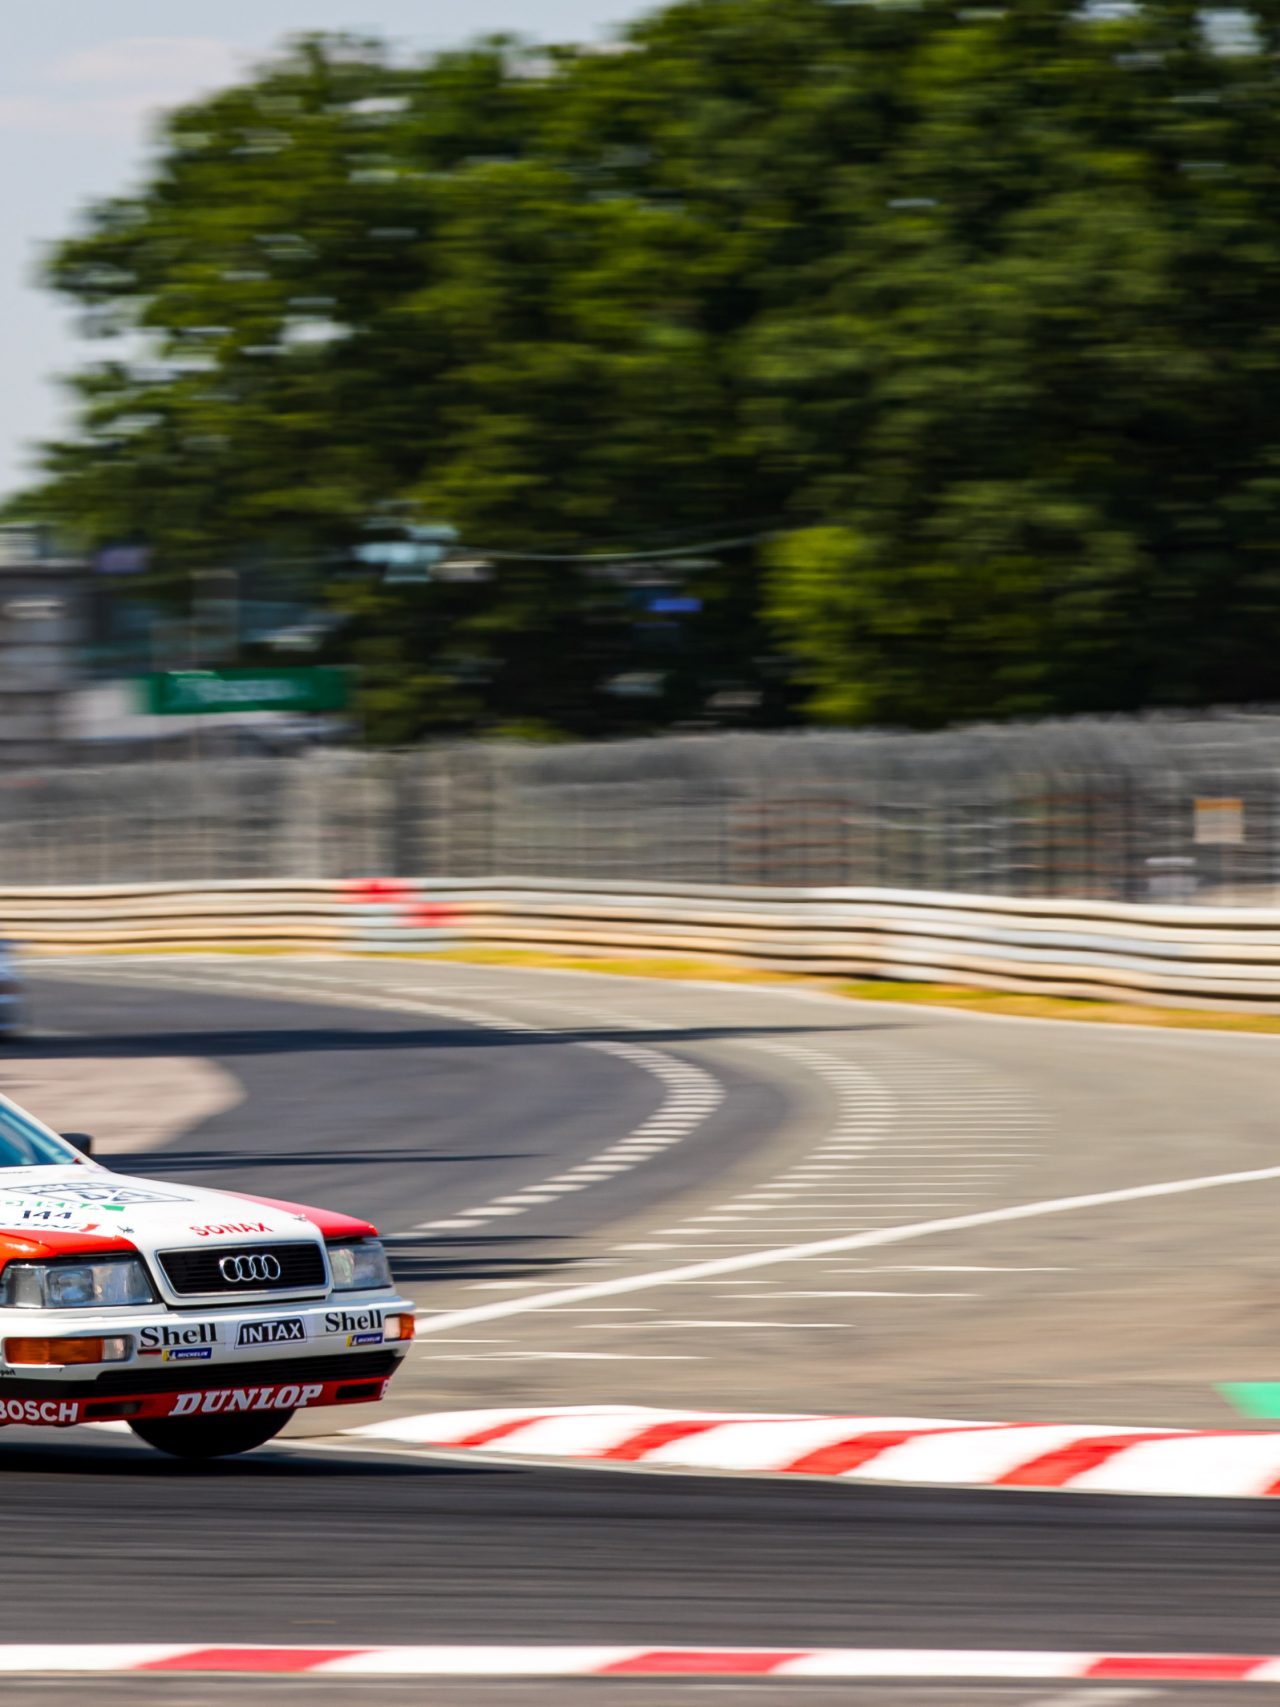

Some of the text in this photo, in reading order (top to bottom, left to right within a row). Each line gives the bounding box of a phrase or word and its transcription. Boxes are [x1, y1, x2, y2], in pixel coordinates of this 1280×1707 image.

[23, 1210, 73, 1220] 144
[189, 1222, 274, 1237] SONAX
[242, 1321, 302, 1343] INTAX
[324, 1309, 384, 1333] Shell
[140, 1323, 218, 1348] Shell
[168, 1384, 324, 1416] DUNLOP
